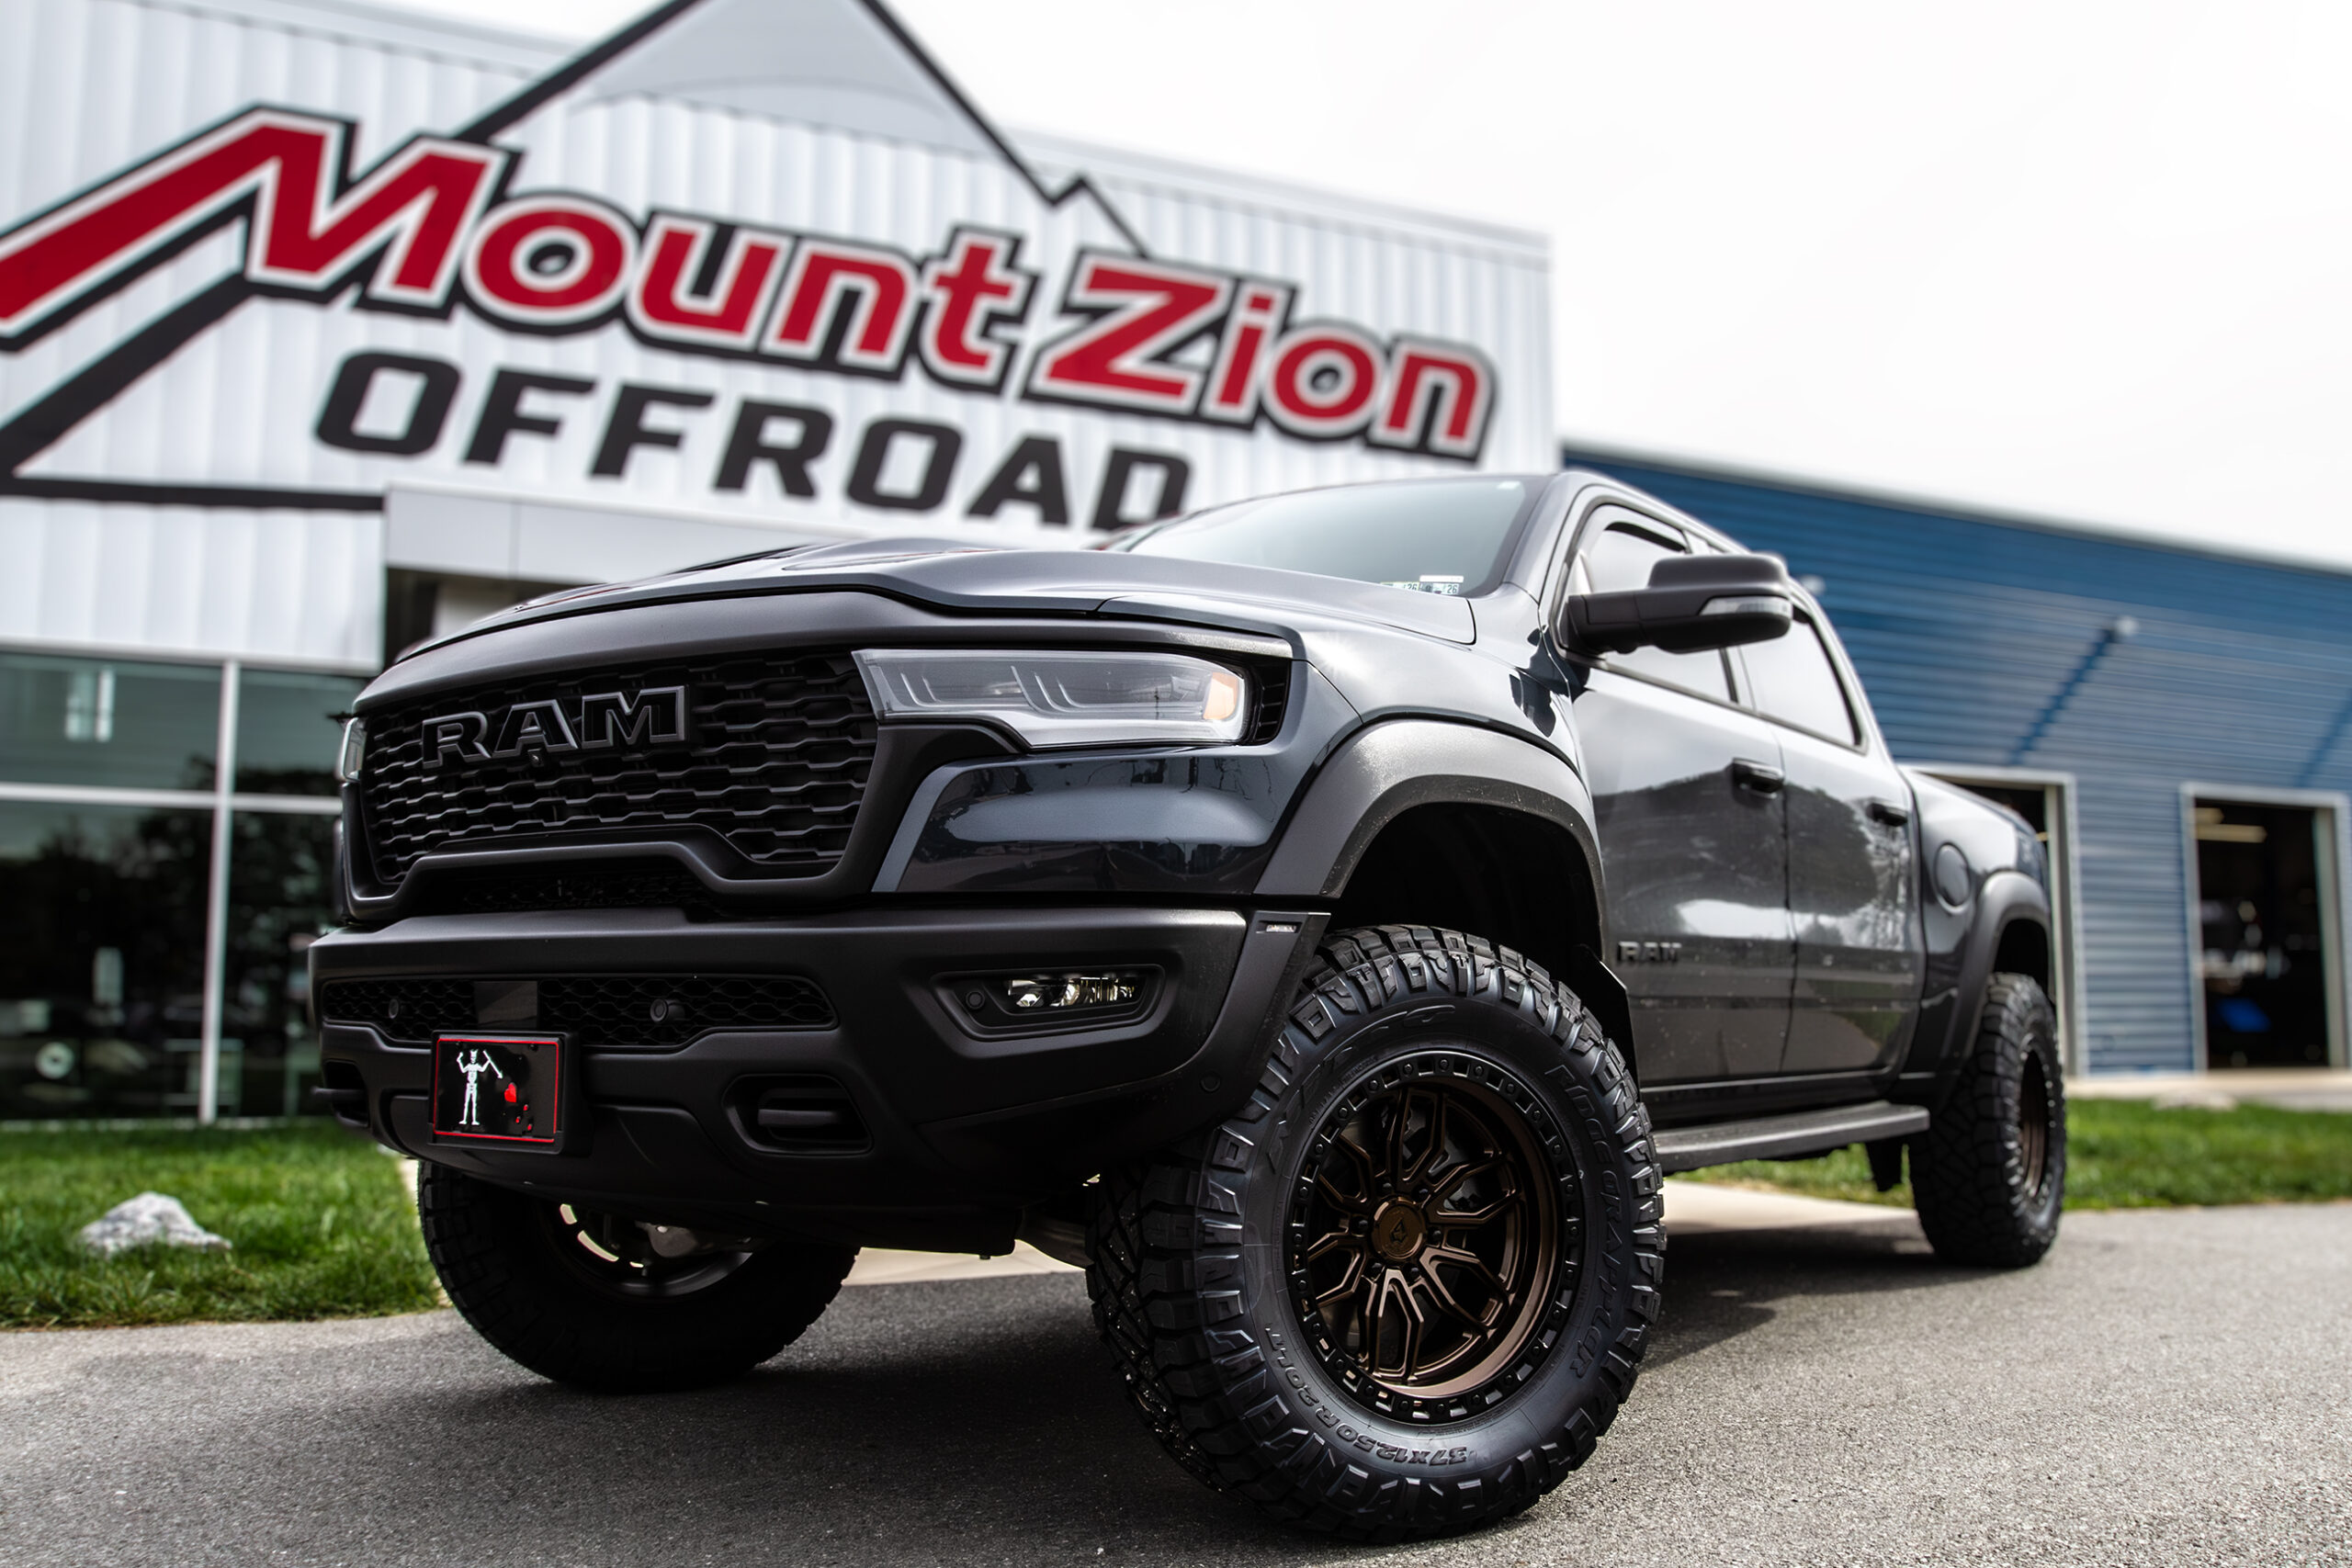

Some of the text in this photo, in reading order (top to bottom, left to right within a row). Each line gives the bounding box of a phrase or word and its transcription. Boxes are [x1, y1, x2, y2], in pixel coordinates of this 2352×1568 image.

[1022, 246, 1497, 465] Zion
[315, 350, 1193, 531] OFFROAD
[423, 685, 687, 770] RAM
[1618, 941, 1683, 963] RAM
[1545, 1064, 1613, 1165] RIDGE
